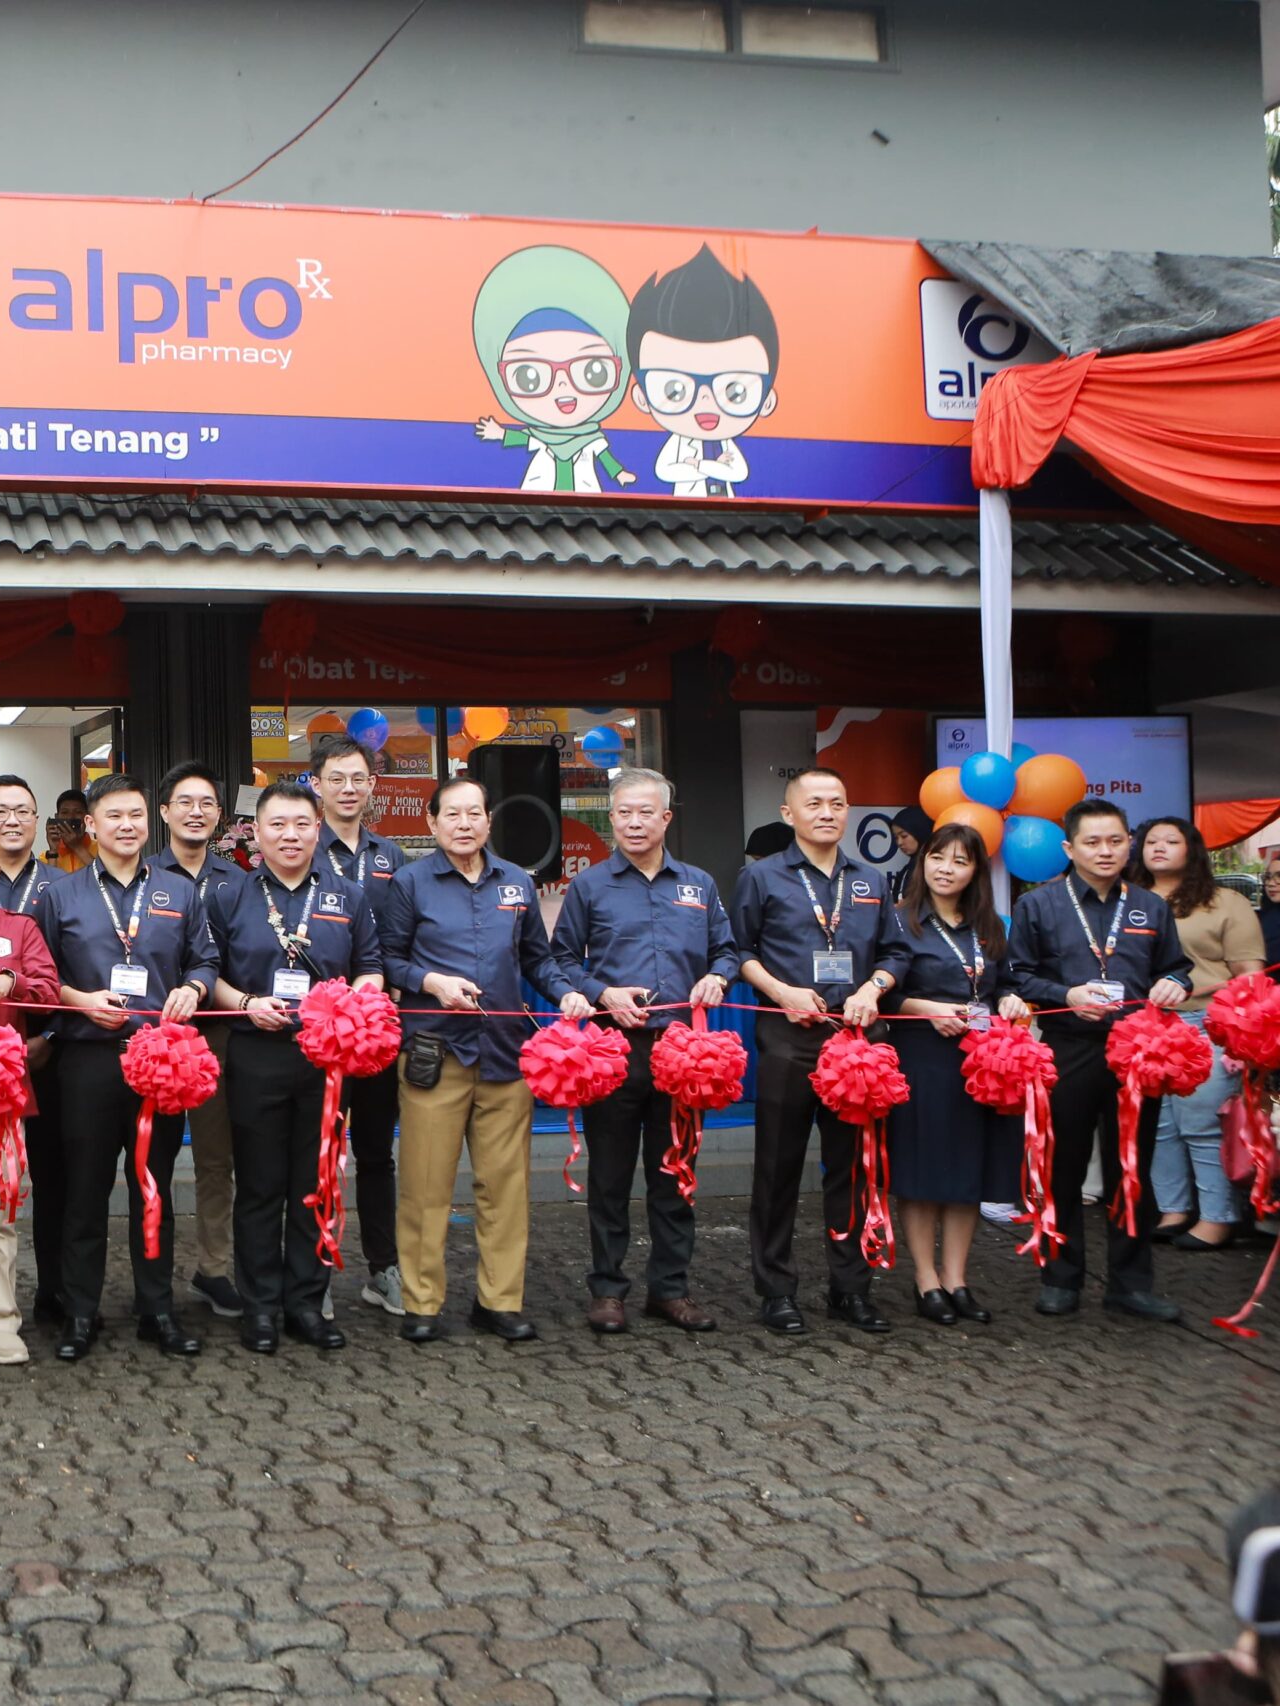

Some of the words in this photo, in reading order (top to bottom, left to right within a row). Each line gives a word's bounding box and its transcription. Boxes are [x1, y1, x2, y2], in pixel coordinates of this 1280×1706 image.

[9, 249, 302, 363] alpro
[141, 339, 292, 369] pharmacy
[48, 423, 189, 460] Tenang
[251, 719, 284, 730] 00%
[948, 741, 970, 750] alpro
[395, 760, 429, 768] 100%
[1110, 781, 1141, 794] Pita
[395, 796, 424, 807] MONEY
[392, 806, 422, 816] BETTER
